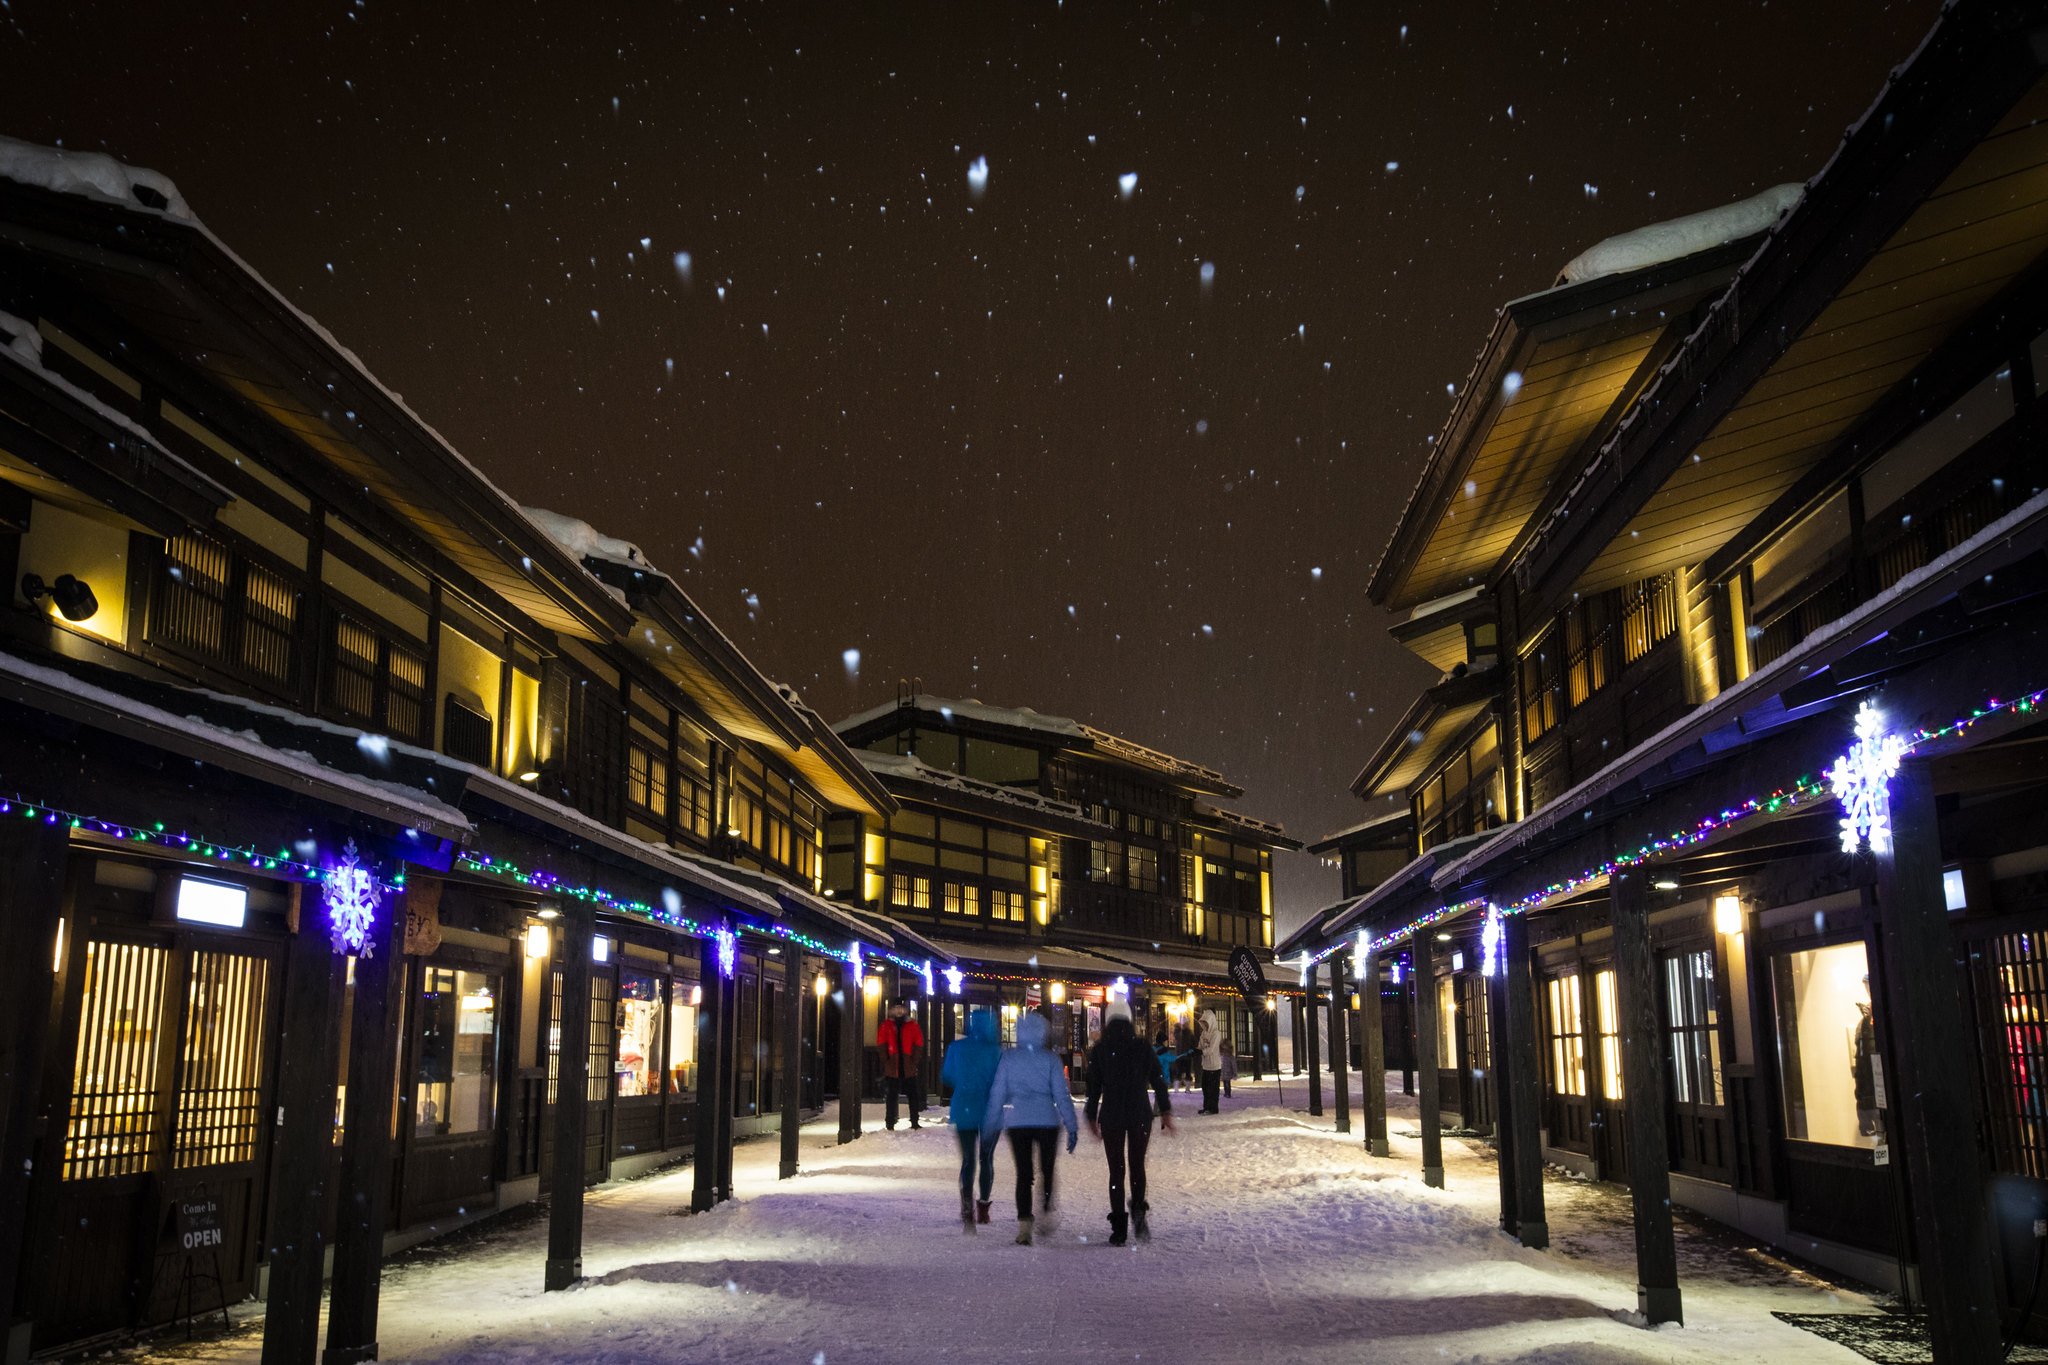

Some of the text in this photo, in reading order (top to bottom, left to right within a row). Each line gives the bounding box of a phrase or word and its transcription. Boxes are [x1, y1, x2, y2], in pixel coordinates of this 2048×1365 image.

[1233, 965, 1250, 992] FITTING
[1238, 963, 1252, 981] BOOT
[1240, 953, 1259, 982] CUSTOM
[183, 1201, 217, 1215] Come In
[183, 1227, 222, 1249] OPEN
